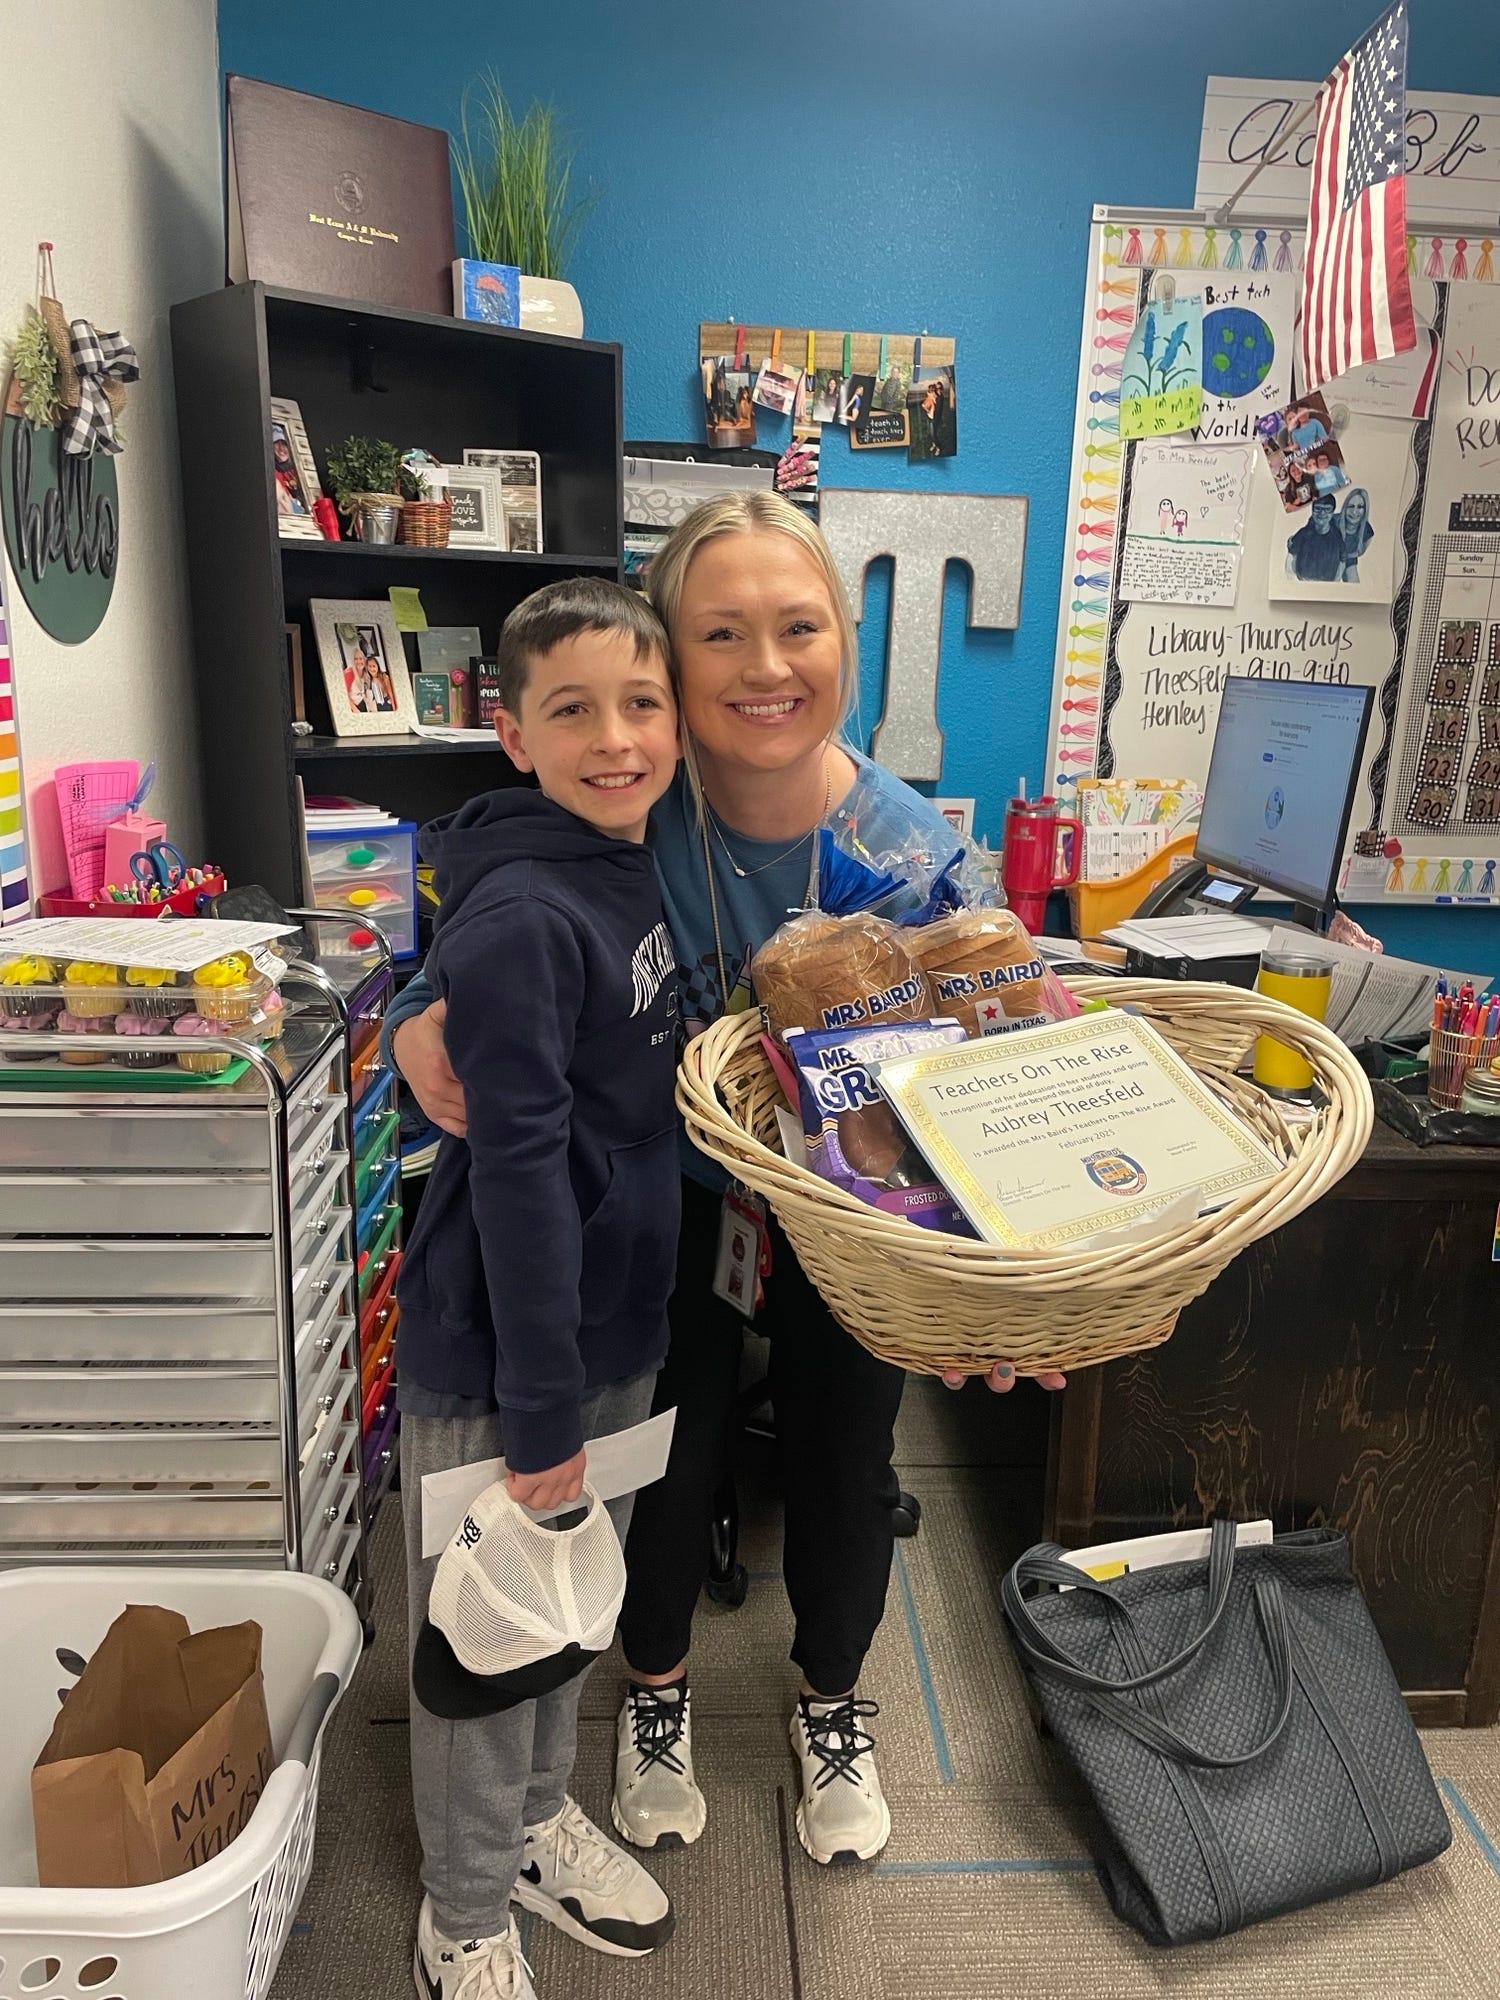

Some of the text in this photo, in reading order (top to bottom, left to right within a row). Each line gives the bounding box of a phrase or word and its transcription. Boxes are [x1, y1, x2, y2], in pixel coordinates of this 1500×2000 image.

[1205, 285, 1239, 305] Best
[1217, 399, 1237, 412] the
[1190, 414, 1260, 441] World!
[13, 419, 117, 582] hello
[1459, 554, 1484, 562] Sunday
[819, 488, 1029, 781] T
[1455, 637, 1464, 656] 2
[1445, 679, 1456, 696] 9
[1438, 720, 1458, 740] 16
[1428, 759, 1450, 778] 23
[1419, 799, 1494, 819] 30 31
[937, 974, 978, 1000] MRS
[822, 999, 867, 1028] MRS
[984, 1016, 1047, 1037] BORN IN TEXAS
[819, 1041, 865, 1071] MRS
[929, 1043, 1132, 1100] Teachers On The Rise
[814, 1067, 886, 1112] GR
[950, 1099, 992, 1114] recognition
[1003, 1094, 1016, 1102] her
[1018, 1083, 1056, 1099] dedication
[1056, 1081, 1066, 1089] to
[1066, 1078, 1079, 1086] her
[1080, 1069, 1112, 1082] students
[1113, 1065, 1126, 1074] and
[1127, 1060, 1148, 1071] going
[990, 1104, 1013, 1114] above
[1015, 1099, 1028, 1108] and
[1030, 1092, 1057, 1105] beyond
[1057, 1088, 1071, 1097] the
[1071, 1084, 1085, 1094] call
[1095, 1078, 1114, 1089] duty.
[982, 1081, 1145, 1138] Aubrey Theesfeld
[983, 1142, 1017, 1156] awarded
[1017, 1136, 1030, 1146] the
[1031, 1134, 1047, 1143] Mrs
[1047, 1126, 1073, 1139] Baird's
[1073, 1116, 1108, 1131] Teachers
[1108, 1113, 1120, 1121] On
[1121, 1109, 1135, 1119] The
[1135, 1104, 1151, 1114] Rise
[1152, 1097, 1176, 1108] Award
[1058, 1128, 1115, 1149] February 2025
[904, 1192, 938, 1207] FROSTED
